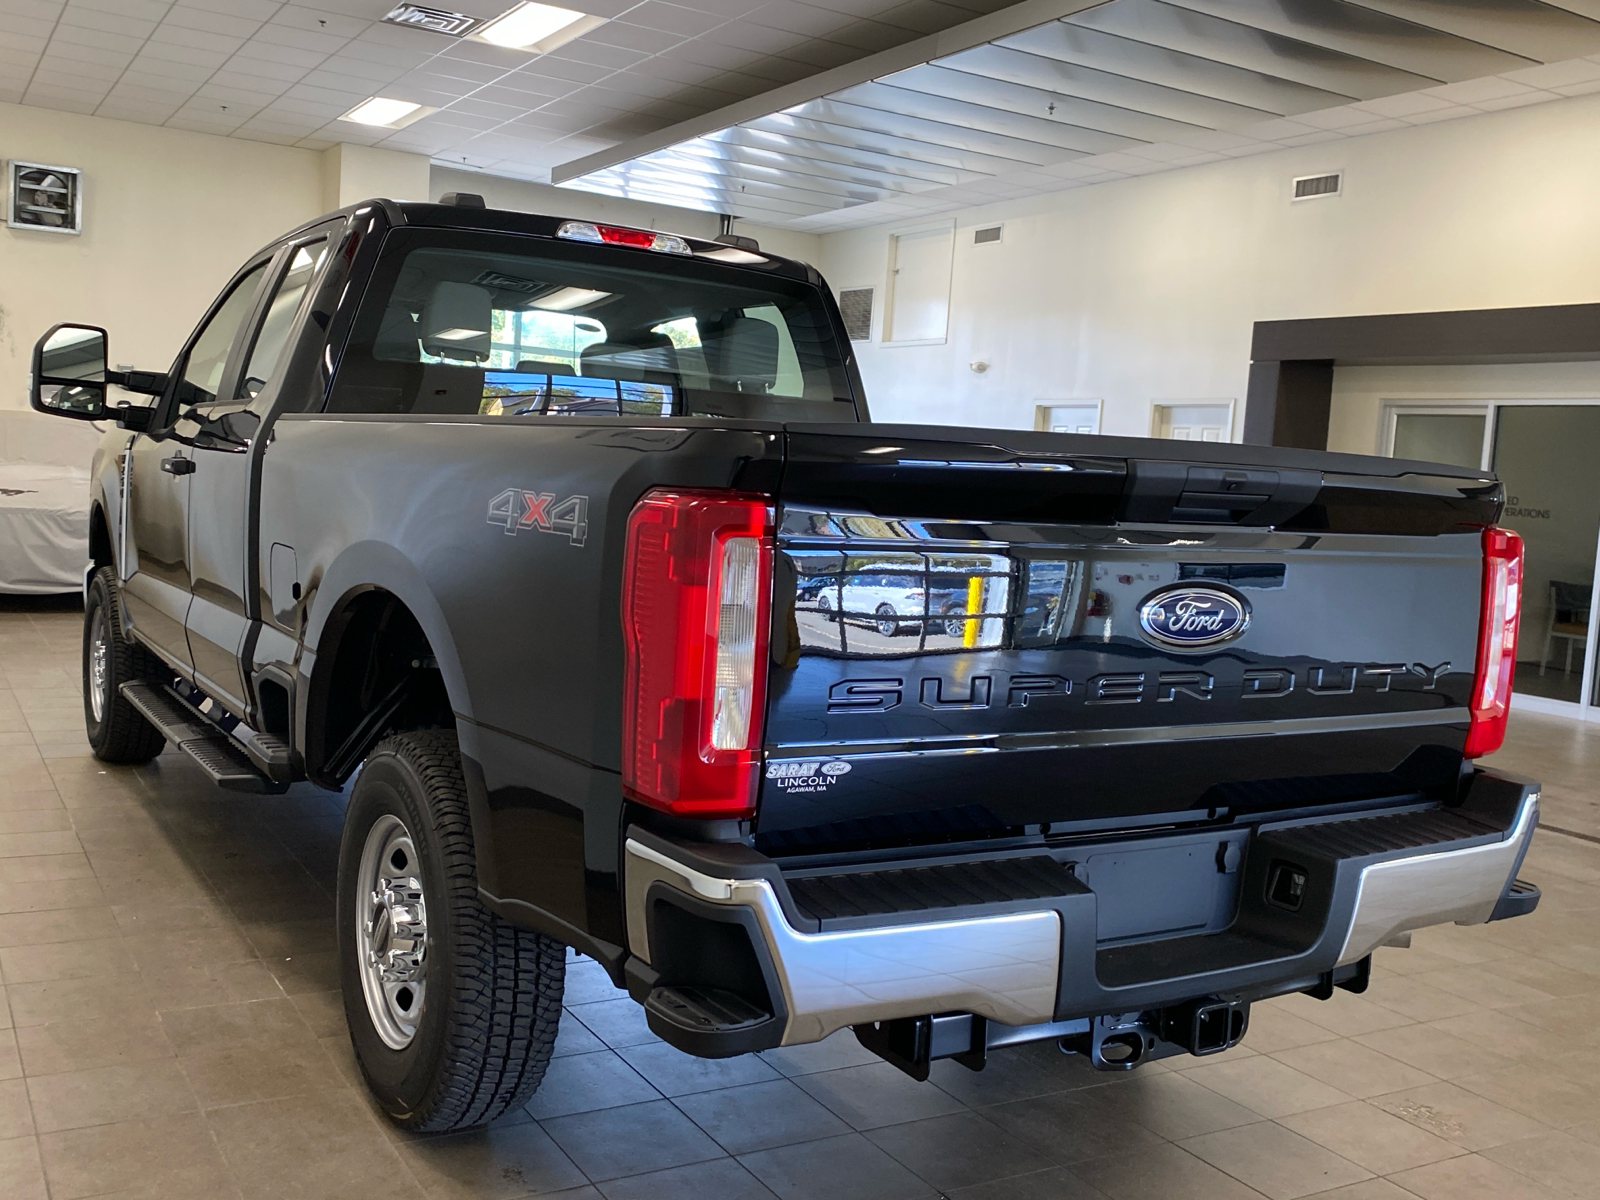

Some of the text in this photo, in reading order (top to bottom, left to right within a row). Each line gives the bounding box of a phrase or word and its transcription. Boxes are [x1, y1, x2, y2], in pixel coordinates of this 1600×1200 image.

[1168, 597, 1225, 631] Ford
[827, 661, 1452, 714] SUPER DUTY
[766, 763, 820, 778] SARAT
[777, 775, 837, 787] LINCOLN
